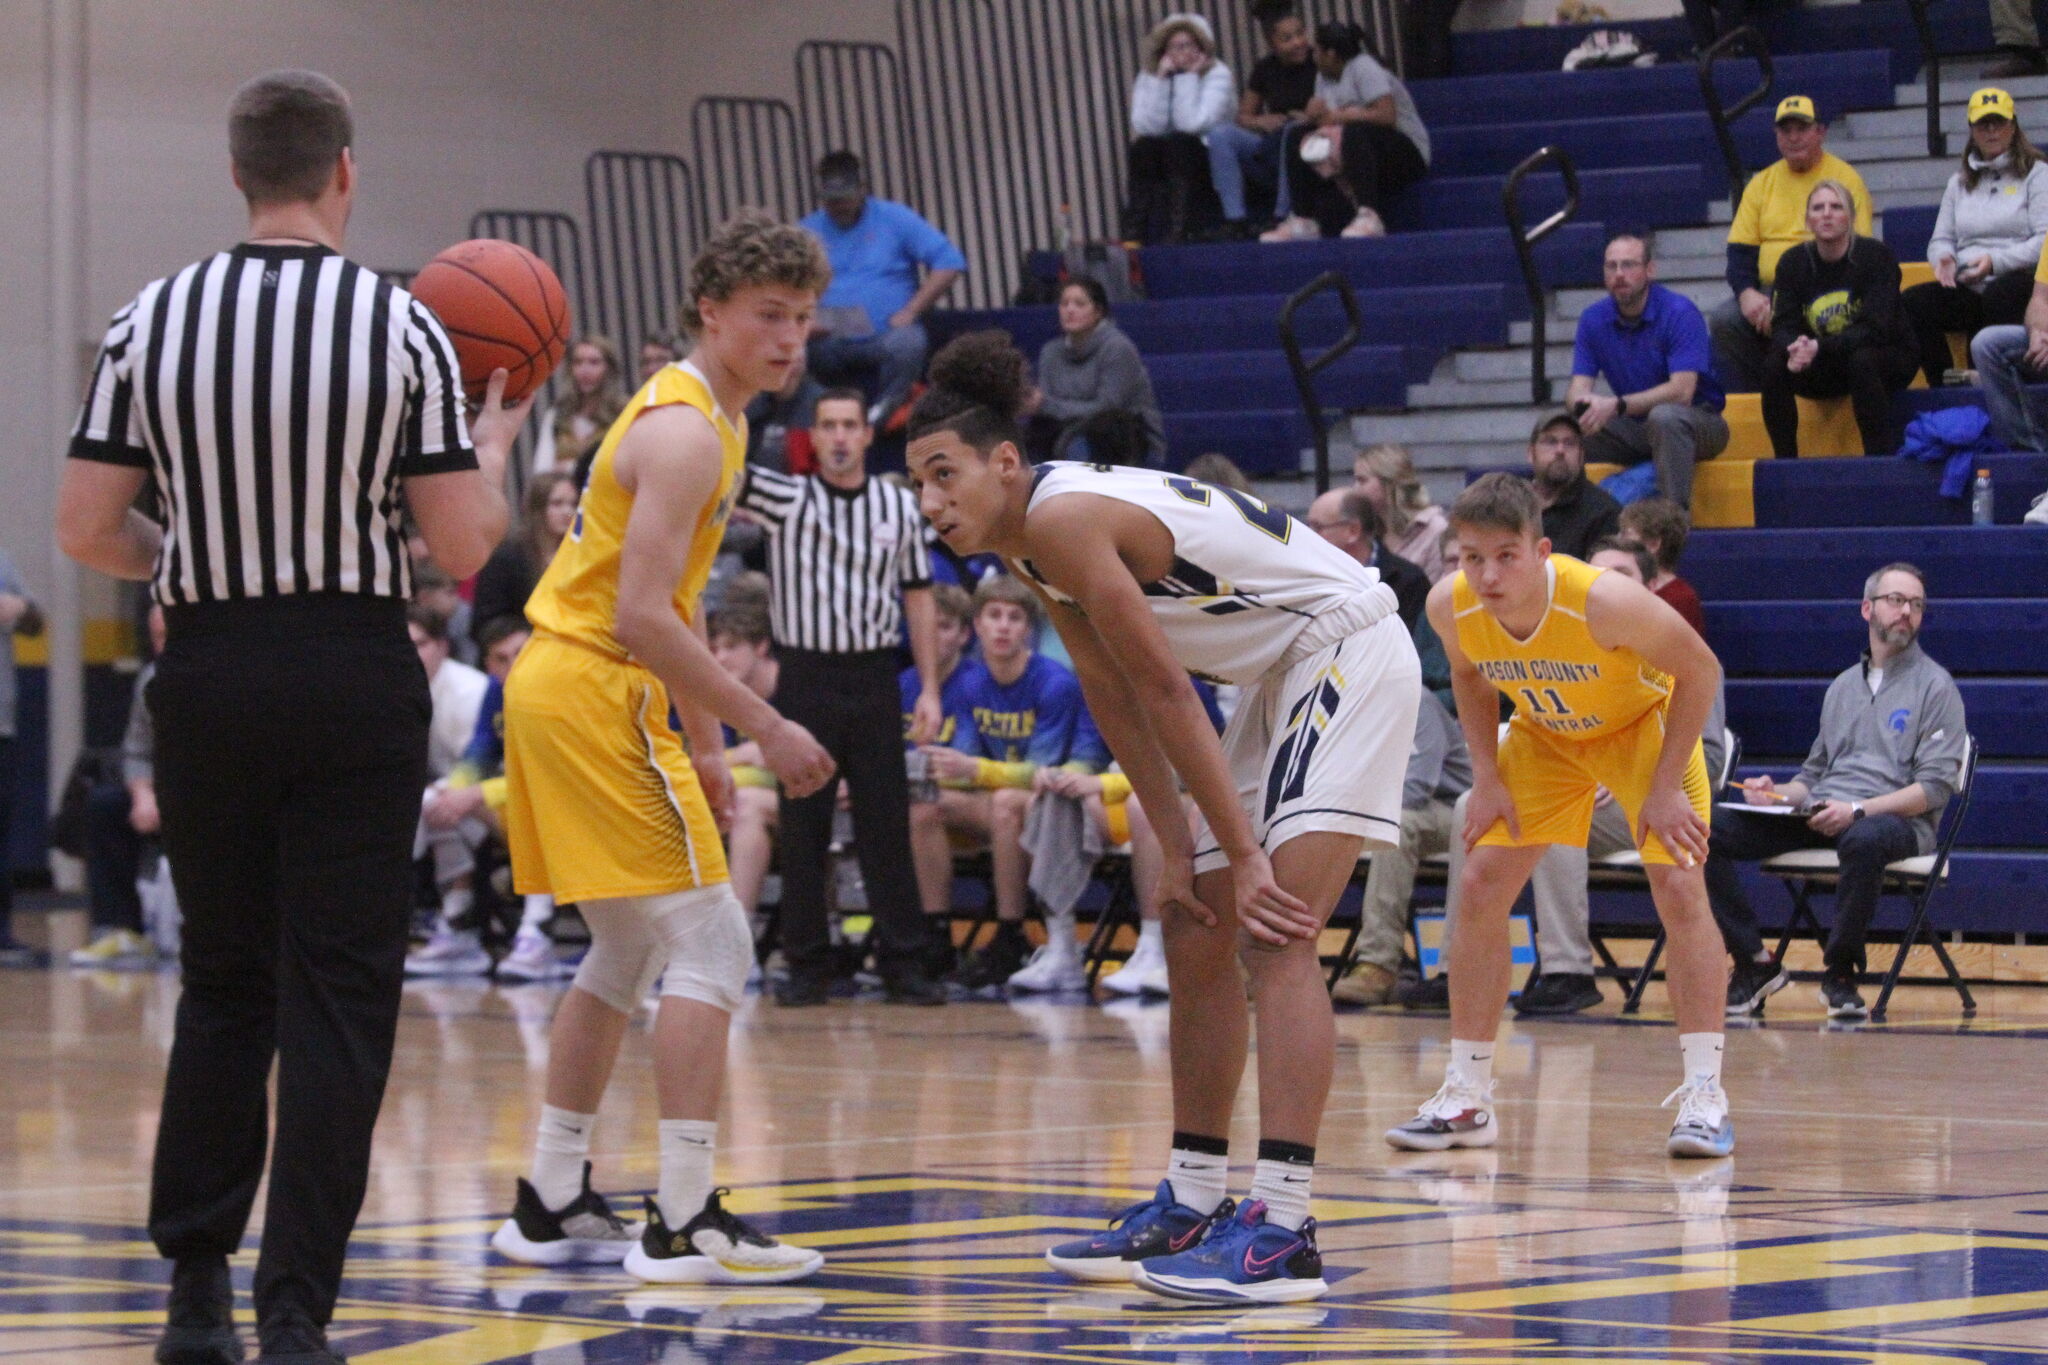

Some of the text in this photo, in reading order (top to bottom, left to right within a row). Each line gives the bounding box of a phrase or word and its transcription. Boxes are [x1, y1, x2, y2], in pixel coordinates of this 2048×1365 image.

[1530, 660, 1600, 681] COUNTY
[1519, 687, 1572, 715] 11
[1533, 714, 1604, 732] NTRAL
